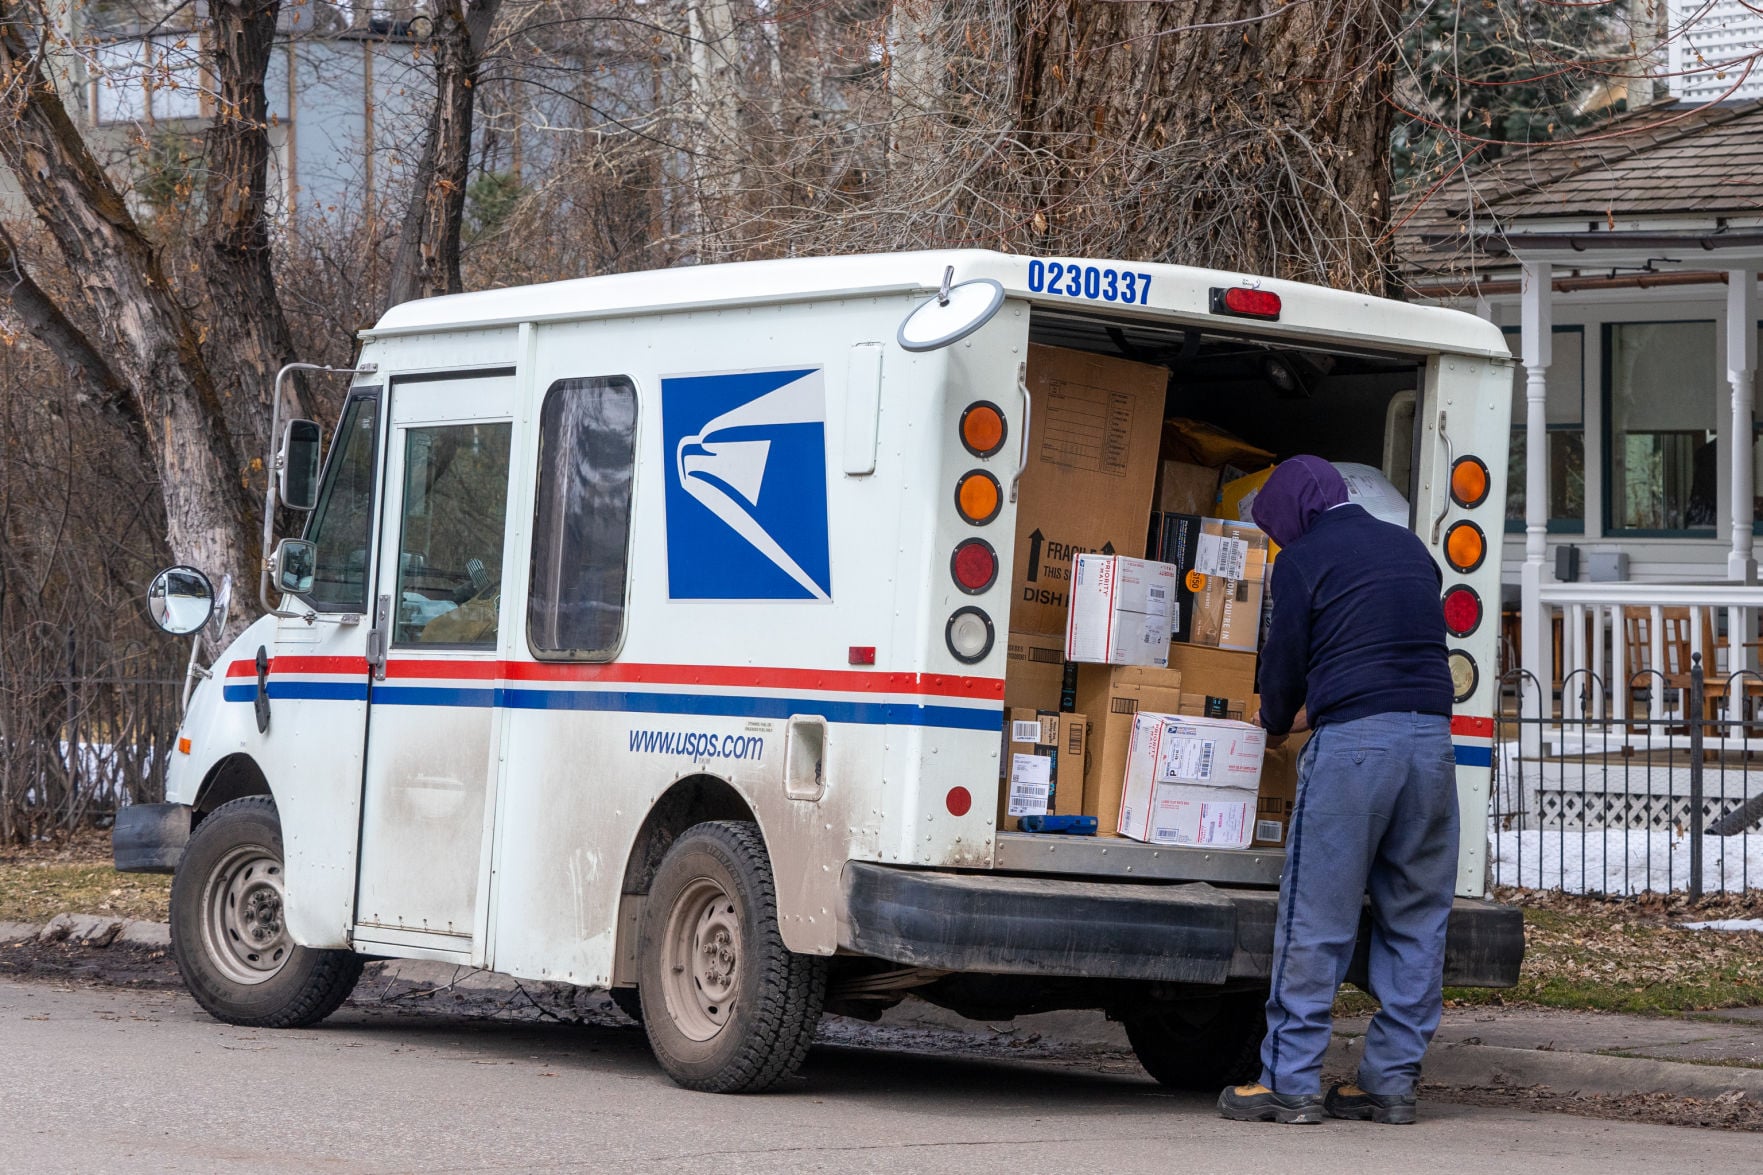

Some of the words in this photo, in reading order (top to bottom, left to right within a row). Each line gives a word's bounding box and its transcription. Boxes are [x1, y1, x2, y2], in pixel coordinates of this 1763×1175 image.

[1028, 260, 1152, 305] 0230337
[1043, 565, 1062, 579] THIS
[1103, 560, 1111, 596] PRIORITY
[1023, 587, 1062, 606] DISH
[1221, 631, 1230, 640] IN
[629, 729, 763, 764] www.usps.com
[1152, 723, 1161, 759] PRIORITY
